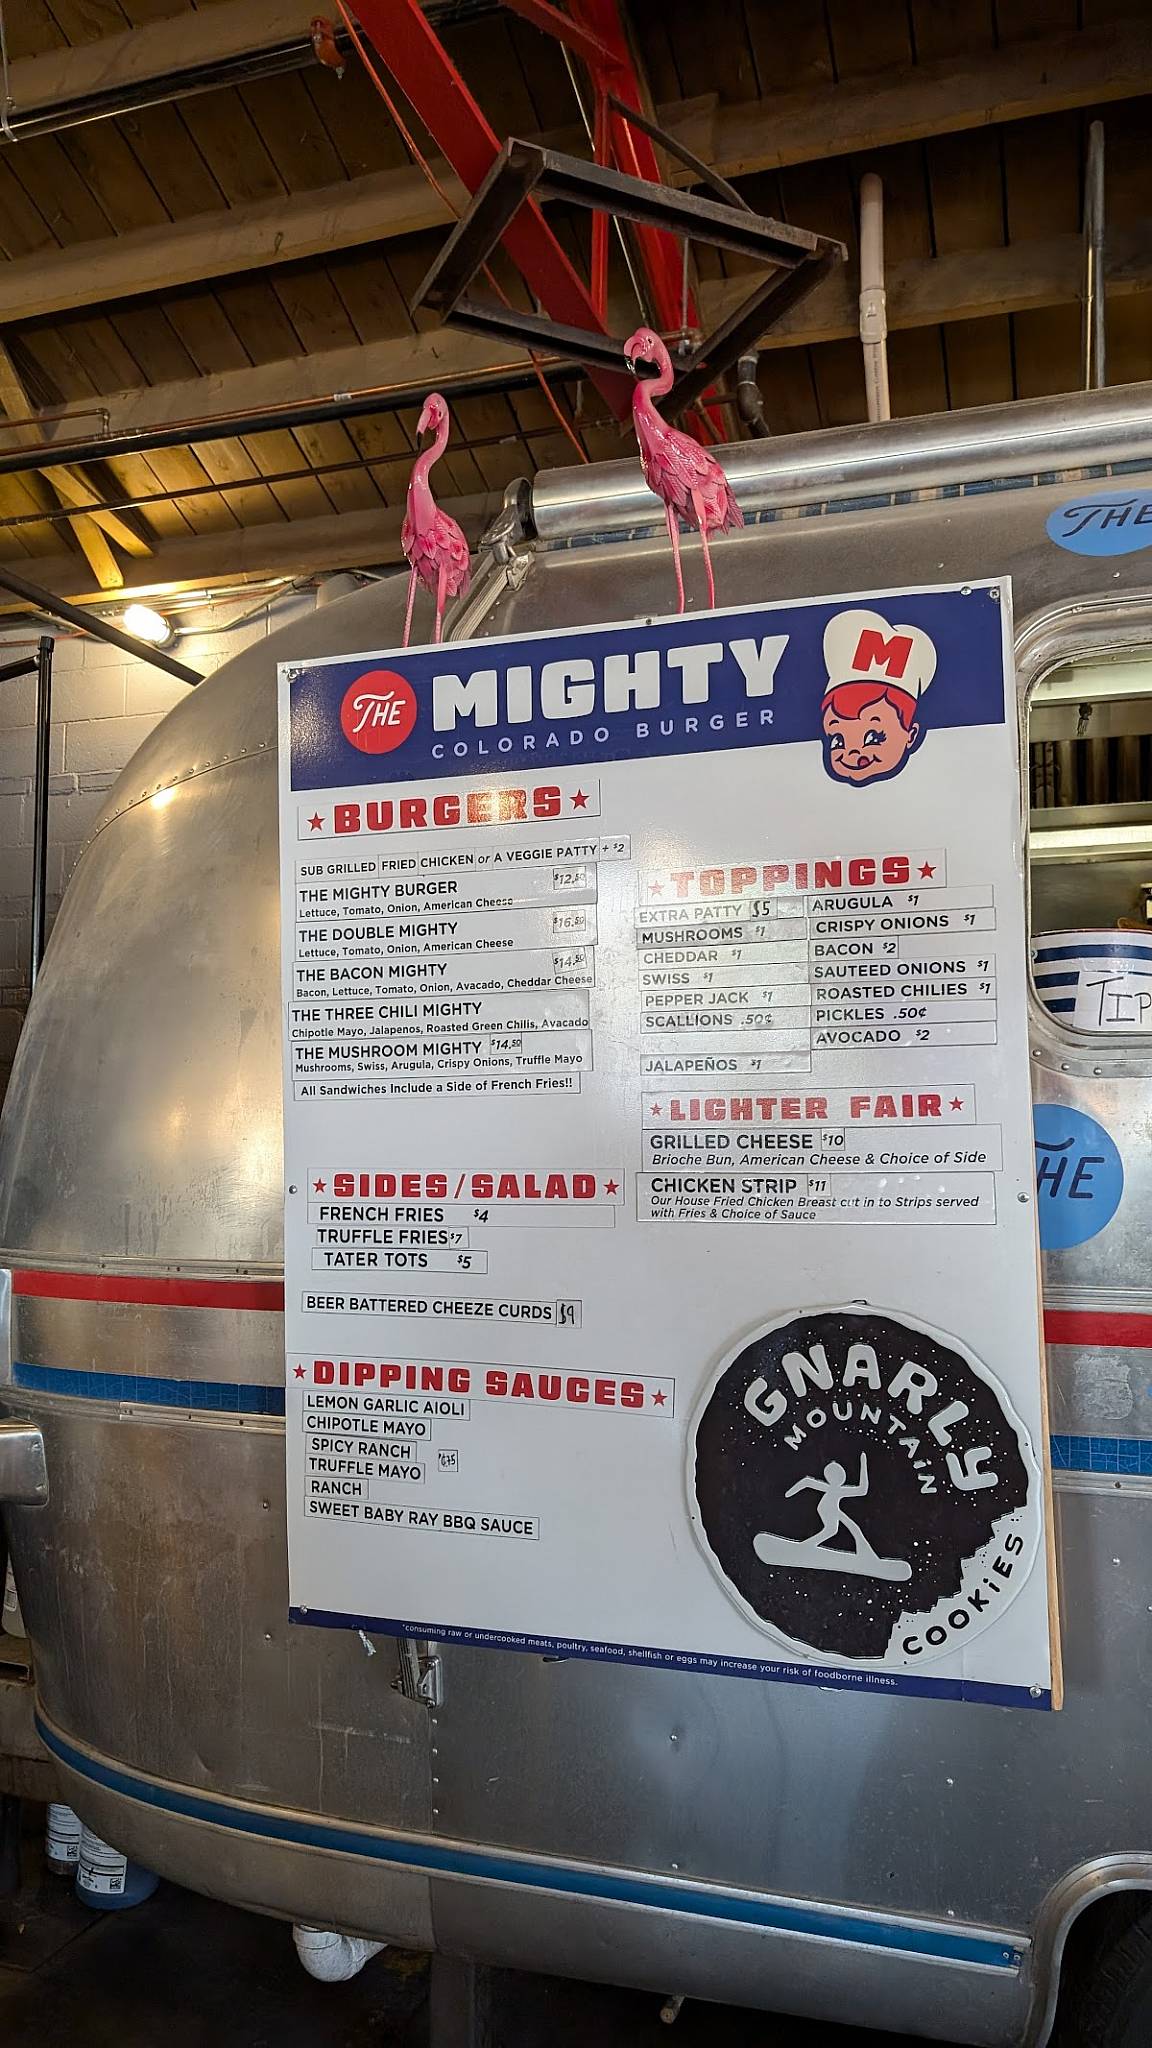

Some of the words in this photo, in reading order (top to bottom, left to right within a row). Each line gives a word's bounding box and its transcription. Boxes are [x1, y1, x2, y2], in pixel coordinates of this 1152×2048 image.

[851, 629, 914, 679] M
[353, 691, 406, 733] THE
[432, 634, 790, 732] MIGHTY
[431, 727, 609, 759] COLORADO
[636, 709, 774, 738] BURGER
[334, 786, 561, 834] BURGERS
[301, 864, 323, 876] SUB
[327, 861, 375, 874] GRILLED
[382, 858, 416, 870] FRIED
[420, 854, 473, 868] CHICKEN
[478, 852, 490, 863] or
[494, 851, 502, 862] A
[506, 848, 552, 861] VEGGIE
[557, 844, 596, 857] PATTY
[614, 842, 624, 853] $2
[671, 856, 910, 898] TOPPINGS
[299, 888, 328, 902] THE
[333, 885, 390, 900] MIGHTY
[395, 882, 457, 897] BURGER
[812, 896, 892, 911] ARUGULA
[908, 895, 918, 906] $1
[639, 908, 688, 923] EXTRA
[694, 905, 741, 920] PATTY
[816, 918, 875, 933] CRISPY
[880, 915, 948, 930] ONIONS
[964, 914, 975, 925] $1
[299, 930, 327, 941] THE
[333, 926, 394, 940] DOUBLE
[399, 923, 457, 937] MIGHTY
[642, 927, 742, 944] MUSHROOMS
[299, 946, 339, 958] Lettuce,
[342, 944, 383, 957] Tomato,
[387, 943, 420, 955] Onion,
[424, 941, 472, 953] American
[476, 939, 513, 951] Cheese
[644, 950, 717, 964] CHEDDAR
[815, 942, 872, 956] BACON
[883, 942, 896, 953] $2
[296, 969, 325, 982] THE
[330, 966, 383, 980] BACON
[389, 963, 447, 978] MIGHTY
[814, 964, 891, 977] SAUTEED
[897, 961, 965, 975] ONIONS
[977, 960, 988, 971] $1
[297, 987, 329, 999] Bacon,
[332, 985, 372, 997] Lettuce,
[375, 983, 416, 995] Tomato,
[420, 981, 452, 993] Onion,
[456, 979, 503, 992] Avacado,
[507, 977, 551, 989] Cheddar
[554, 976, 593, 987] Cheese
[643, 973, 689, 985] SWISS
[646, 993, 703, 1006] PEPPER
[708, 991, 748, 1004] JACK
[817, 986, 894, 1000] ROASTED
[901, 983, 967, 998] CHILIES
[979, 982, 990, 994] $1
[292, 1009, 320, 1022] THE
[325, 1007, 373, 1021] THREE
[378, 1005, 417, 1019] CHILI
[423, 1003, 481, 1017] MIGHTY
[646, 1014, 732, 1027] SCALLIONS
[816, 1008, 884, 1021] PICKLES
[816, 1030, 900, 1044] AVOCADO
[916, 1029, 929, 1041] $2
[295, 1047, 323, 1060] THE
[329, 1044, 417, 1059] MUSHROOM
[423, 1042, 481, 1056] MIGHTY
[296, 1061, 354, 1074] Mushrooms,
[358, 1060, 387, 1072] Swiss,
[391, 1059, 433, 1071] Arugula,
[437, 1058, 470, 1070] Crispy
[473, 1056, 512, 1068] Onions,
[516, 1055, 550, 1067] Truffle
[554, 1054, 582, 1066] Mayo
[646, 1057, 737, 1072] JALAPEÑOS
[301, 1086, 315, 1095] All
[320, 1084, 386, 1095] Sandwiches
[390, 1082, 432, 1093] Include
[436, 1082, 442, 1092] a
[446, 1081, 471, 1092] Side
[476, 1080, 487, 1091] of
[492, 1079, 531, 1090] French
[536, 1078, 572, 1089] Fries!!
[670, 1097, 828, 1121] LIGHTER
[850, 1094, 942, 1119] FAIR
[650, 1135, 729, 1149] GRILLED
[737, 1134, 812, 1149] CHEESE
[821, 1134, 845, 1146] $10
[1034, 1137, 1105, 1200] HE
[333, 1173, 597, 1199] SIDES/SALAD
[651, 1178, 734, 1193] CHICKEN
[742, 1178, 796, 1193] STRIP
[808, 1180, 826, 1191] $11
[320, 1207, 388, 1222] FRENCH
[395, 1208, 443, 1222] FRIES
[474, 1209, 488, 1223] $4
[317, 1230, 393, 1244] TRUFFLE
[400, 1230, 447, 1245] FRIES
[450, 1233, 462, 1244] $7
[324, 1252, 377, 1267] TATER
[384, 1253, 427, 1267] TOTS
[307, 1296, 344, 1311] BEER
[350, 1298, 427, 1315] BATTERED
[433, 1301, 493, 1317] CHEEZE
[498, 1304, 551, 1320] CURDS
[313, 1360, 471, 1393] DIPPING
[485, 1370, 645, 1409] SAUCES
[308, 1396, 358, 1411] LEMON
[364, 1398, 418, 1414] GARLIC
[423, 1401, 463, 1416] AIOLI
[307, 1416, 378, 1434] CHIPOTLE
[384, 1420, 425, 1436] MAYO
[312, 1438, 353, 1454] SPICY
[359, 1441, 410, 1458] RANCH
[309, 1458, 373, 1476] TRUFFLE
[379, 1463, 420, 1480] MAYO
[312, 1480, 361, 1496] RANCH
[310, 1501, 359, 1519] SWEET
[364, 1506, 403, 1523] BABY
[409, 1510, 438, 1526] RAY
[444, 1513, 475, 1529] BBQ
[481, 1516, 532, 1534] SAUCE
[475, 1634, 525, 1645] undercooked
[528, 1640, 554, 1648] meats,
[557, 1642, 587, 1652] poultry,
[590, 1646, 625, 1656] seafood,
[628, 1650, 662, 1659] shellfish
[676, 1656, 697, 1665] eggs
[720, 1660, 757, 1671] increase
[783, 1666, 799, 1675] risk
[814, 1670, 862, 1682] foodborne
[866, 1676, 897, 1686] illness.
